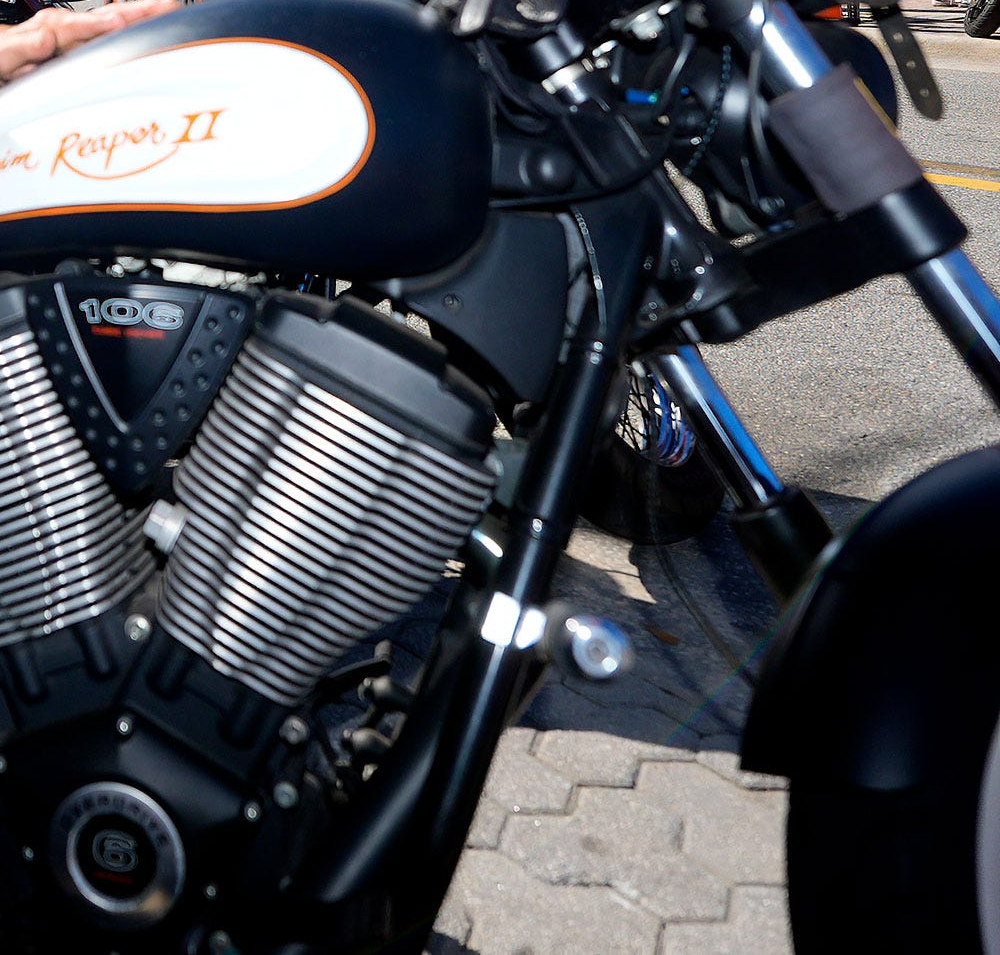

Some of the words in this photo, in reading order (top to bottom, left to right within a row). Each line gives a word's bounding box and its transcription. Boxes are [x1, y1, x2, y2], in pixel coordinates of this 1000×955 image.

[50, 121, 170, 180] Reaper
[170, 108, 228, 146] II
[79, 297, 185, 331] 106
[92, 829, 139, 873] 6
